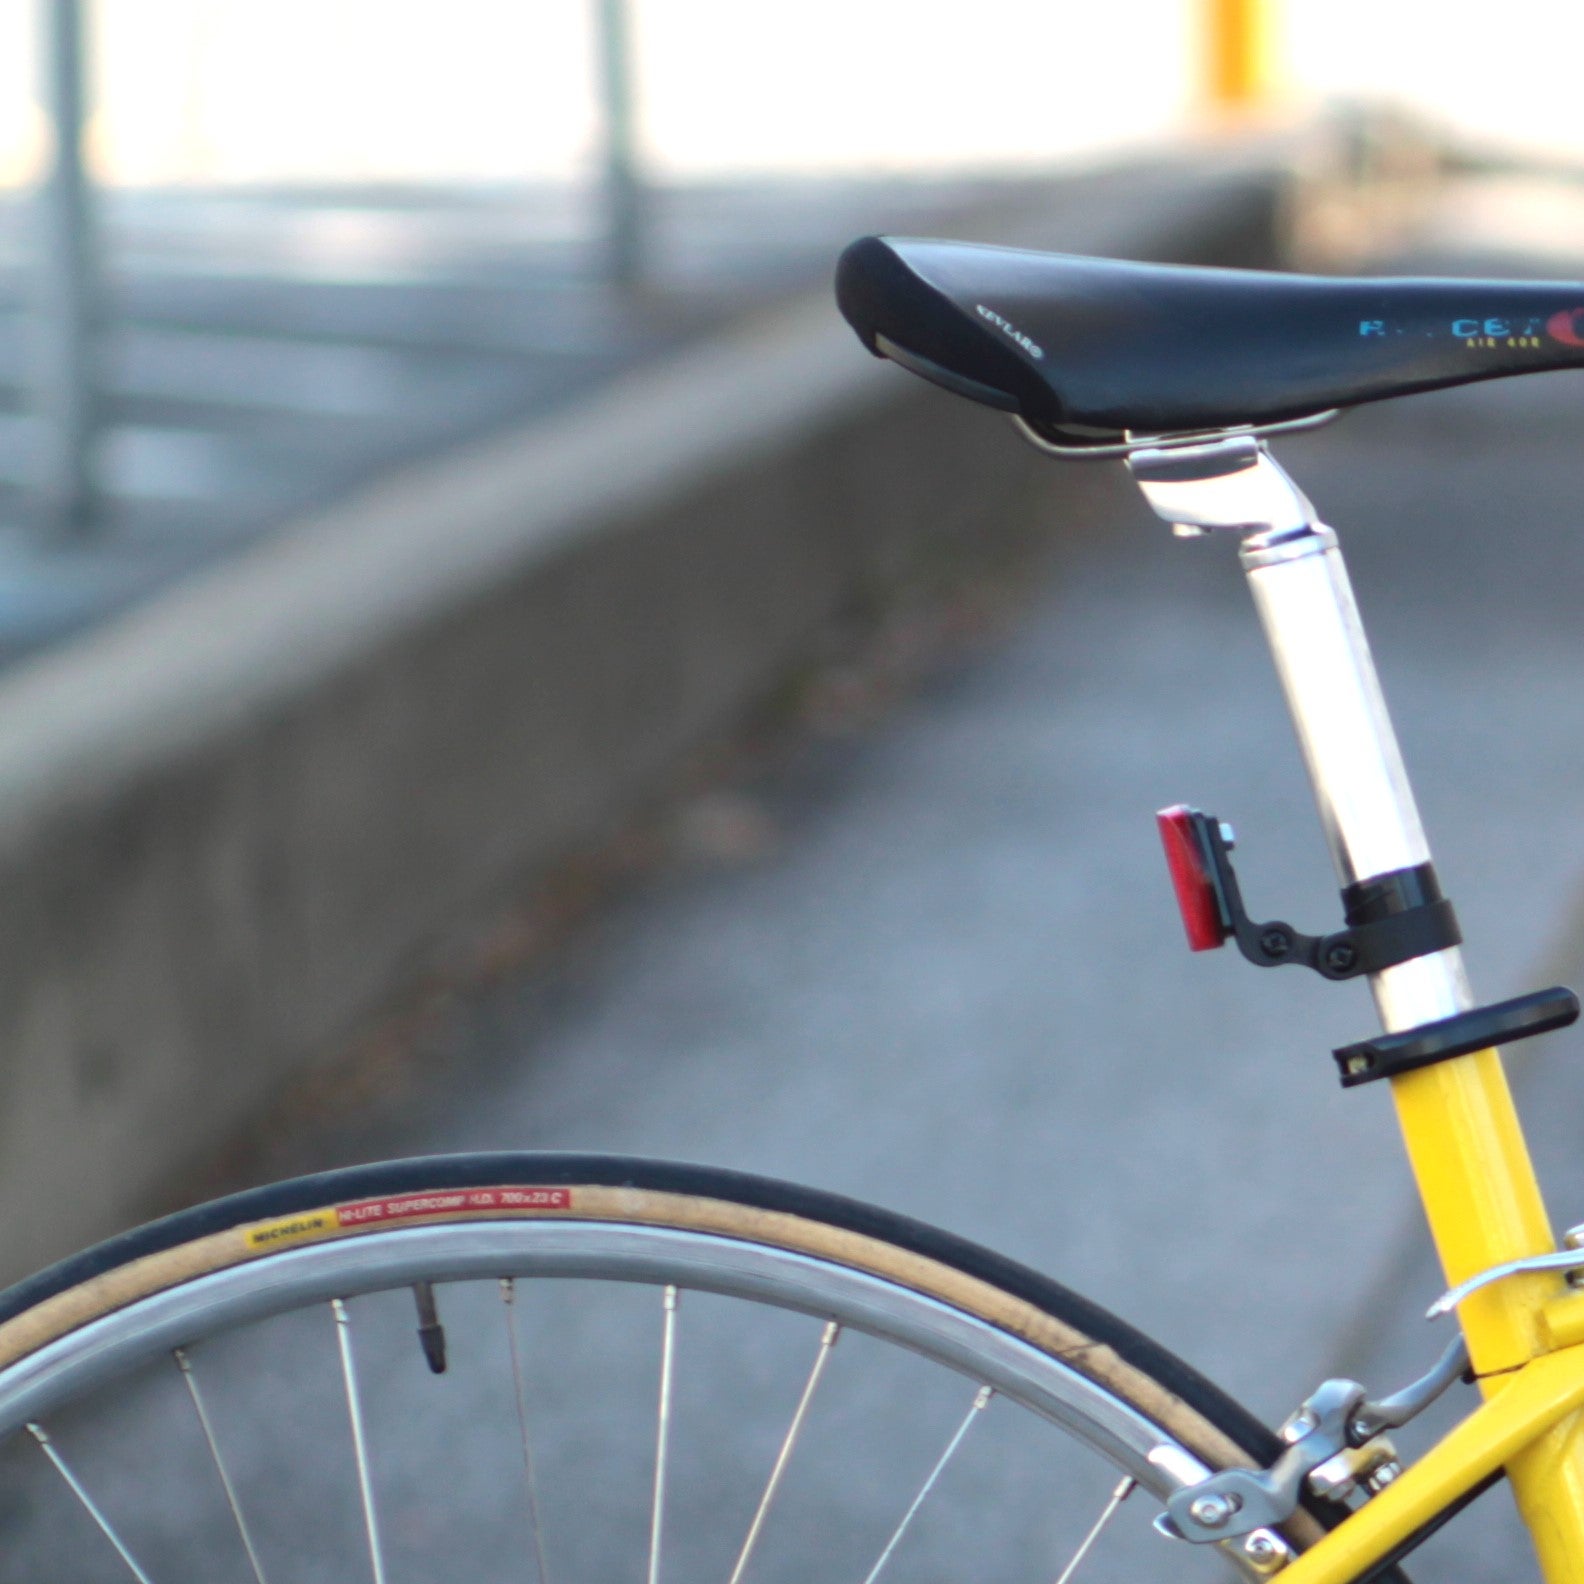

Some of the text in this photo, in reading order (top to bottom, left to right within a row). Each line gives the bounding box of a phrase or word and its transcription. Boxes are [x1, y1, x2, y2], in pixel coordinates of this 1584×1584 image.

[253, 1219, 324, 1243] MICHELIN
[339, 1204, 382, 1222] HI-LITE
[386, 1194, 466, 1214] SUPERCOMP
